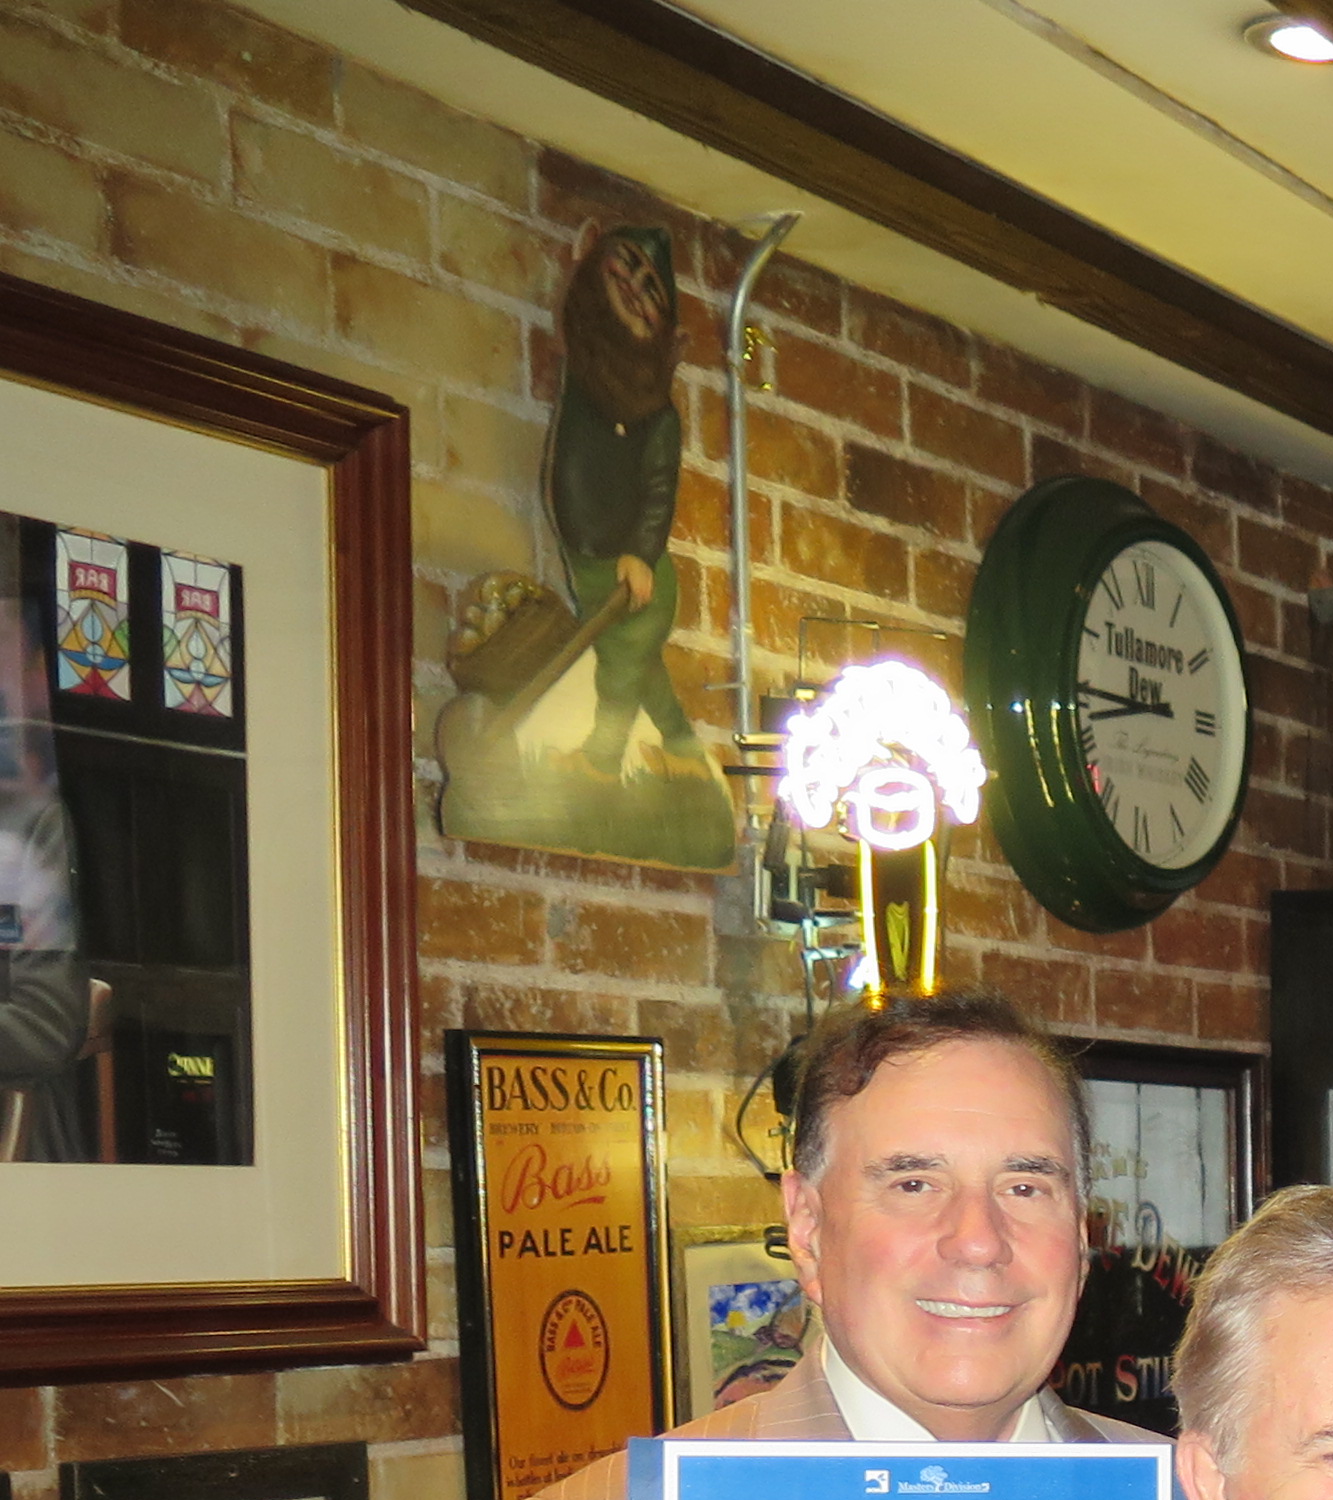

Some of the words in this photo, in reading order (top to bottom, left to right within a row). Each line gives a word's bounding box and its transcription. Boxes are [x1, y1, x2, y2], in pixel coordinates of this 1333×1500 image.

[1104, 620, 1185, 676] Tullamore
[1129, 665, 1163, 704] Dew
[486, 1066, 571, 1112] BASS
[502, 1143, 612, 1215] Bass
[498, 1228, 576, 1260] PALE
[582, 1225, 633, 1256] ALE
